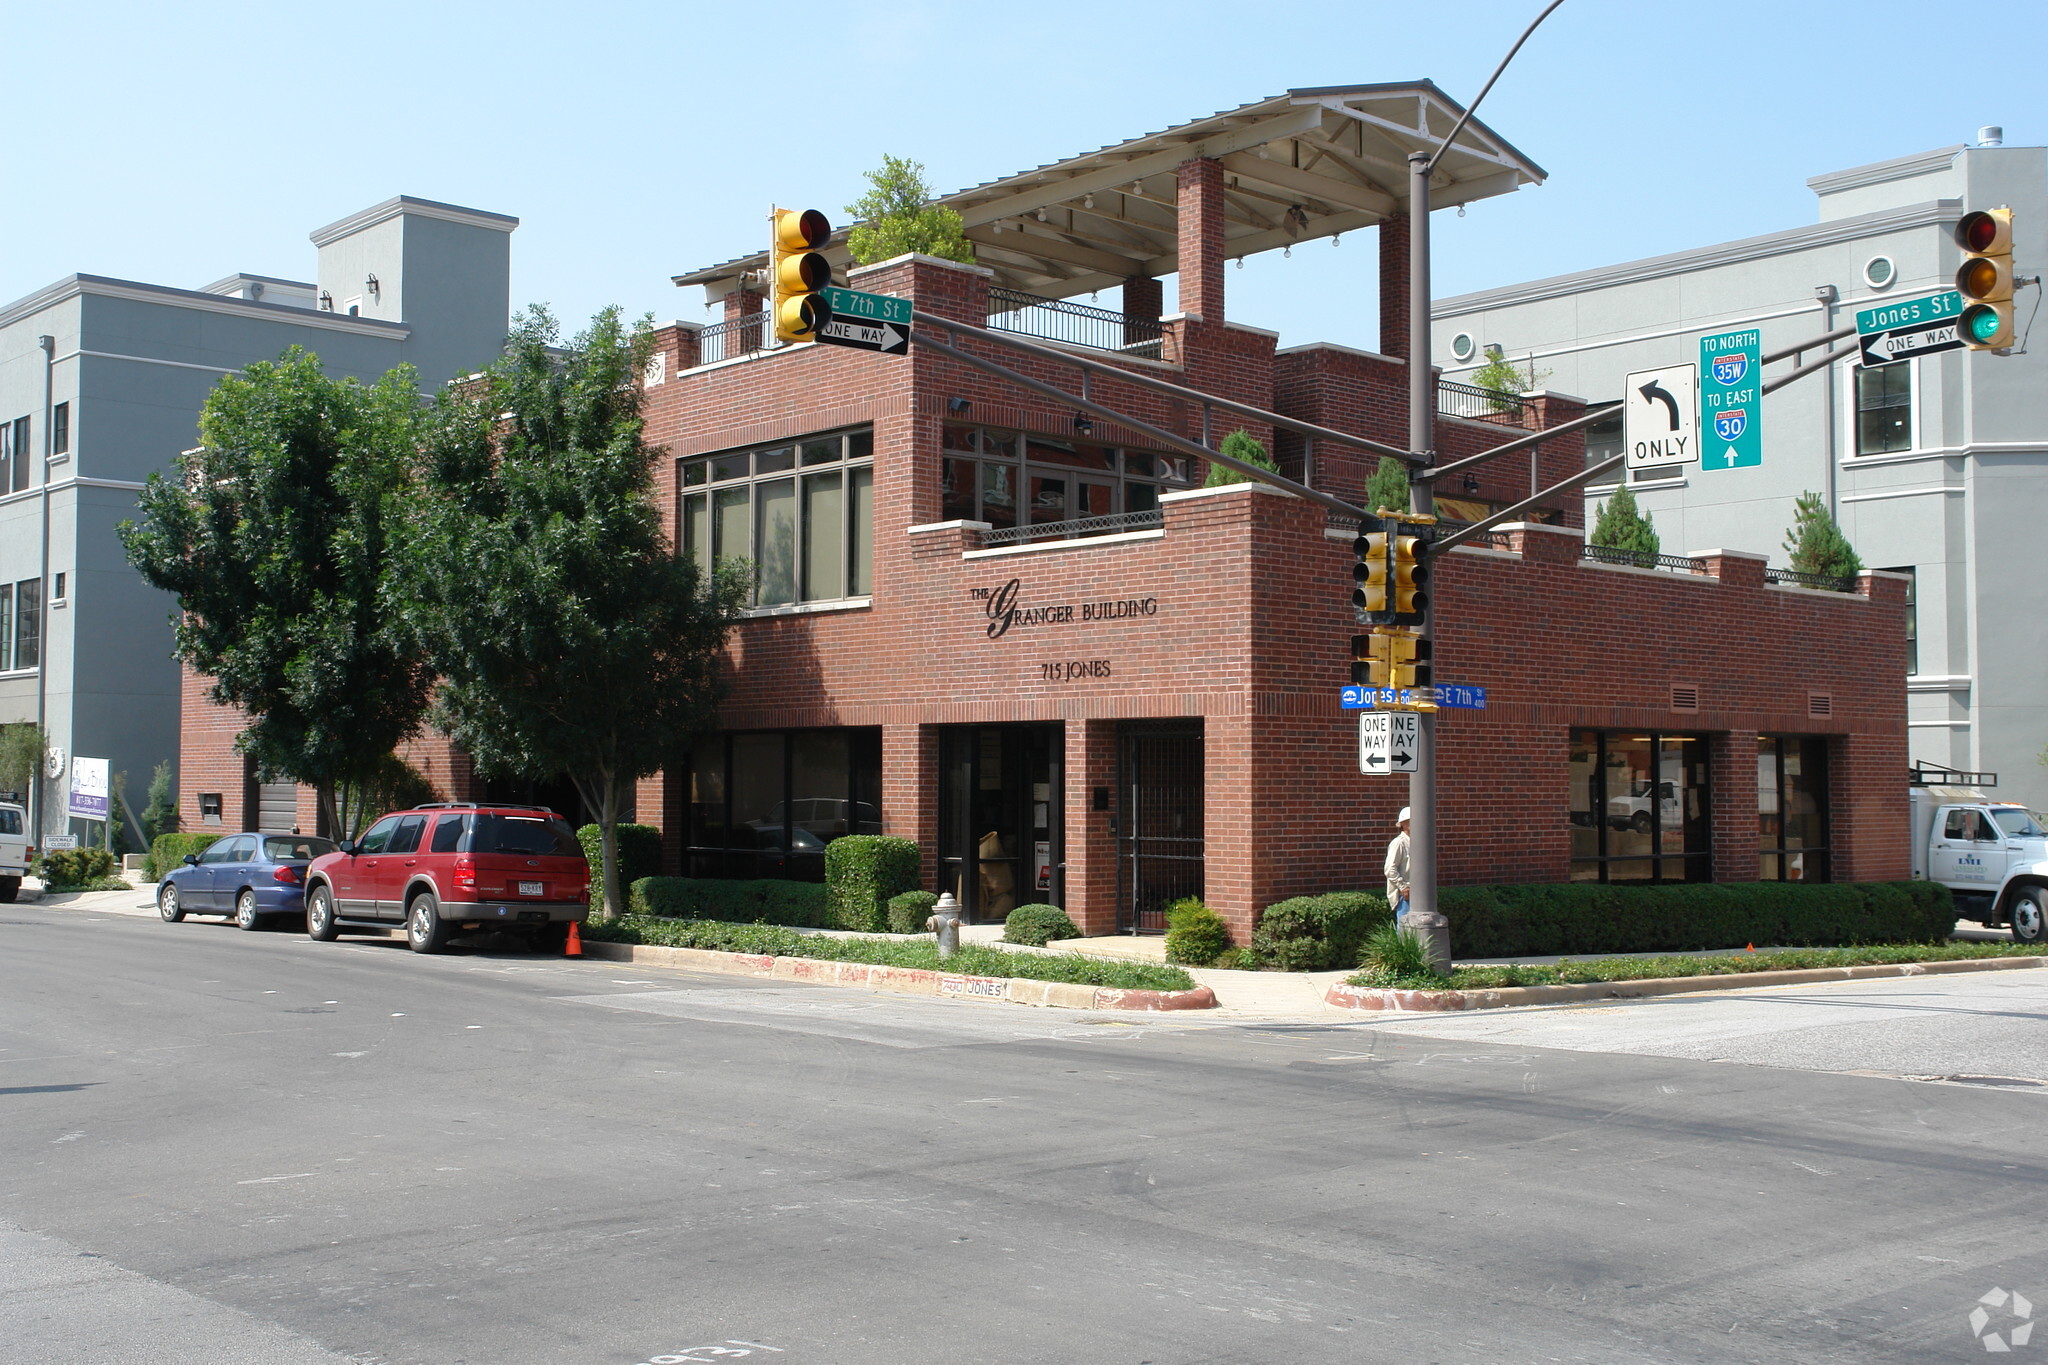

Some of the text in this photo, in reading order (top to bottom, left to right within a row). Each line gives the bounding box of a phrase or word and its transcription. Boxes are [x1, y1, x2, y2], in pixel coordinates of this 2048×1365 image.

[832, 292, 900, 318] E 7th St
[1868, 295, 1951, 328] Jones St
[825, 323, 887, 342] ONE WAY
[1886, 327, 1955, 352] ONE WAY
[1703, 332, 1757, 352] TO NORTH
[1717, 362, 1742, 380] 35W
[1707, 389, 1754, 407] TO EAST
[1720, 418, 1741, 436] 30
[1635, 436, 1688, 459] ONLY
[970, 587, 989, 600] THE
[1083, 597, 1157, 621] BUILDING
[1041, 660, 1111, 682] 715 JONES
[1445, 687, 1472, 705] E 7th
[1364, 718, 1387, 732] ONE
[1391, 717, 1415, 731] NE
[1364, 735, 1387, 749] WAY
[968, 982, 1001, 996] JONES
